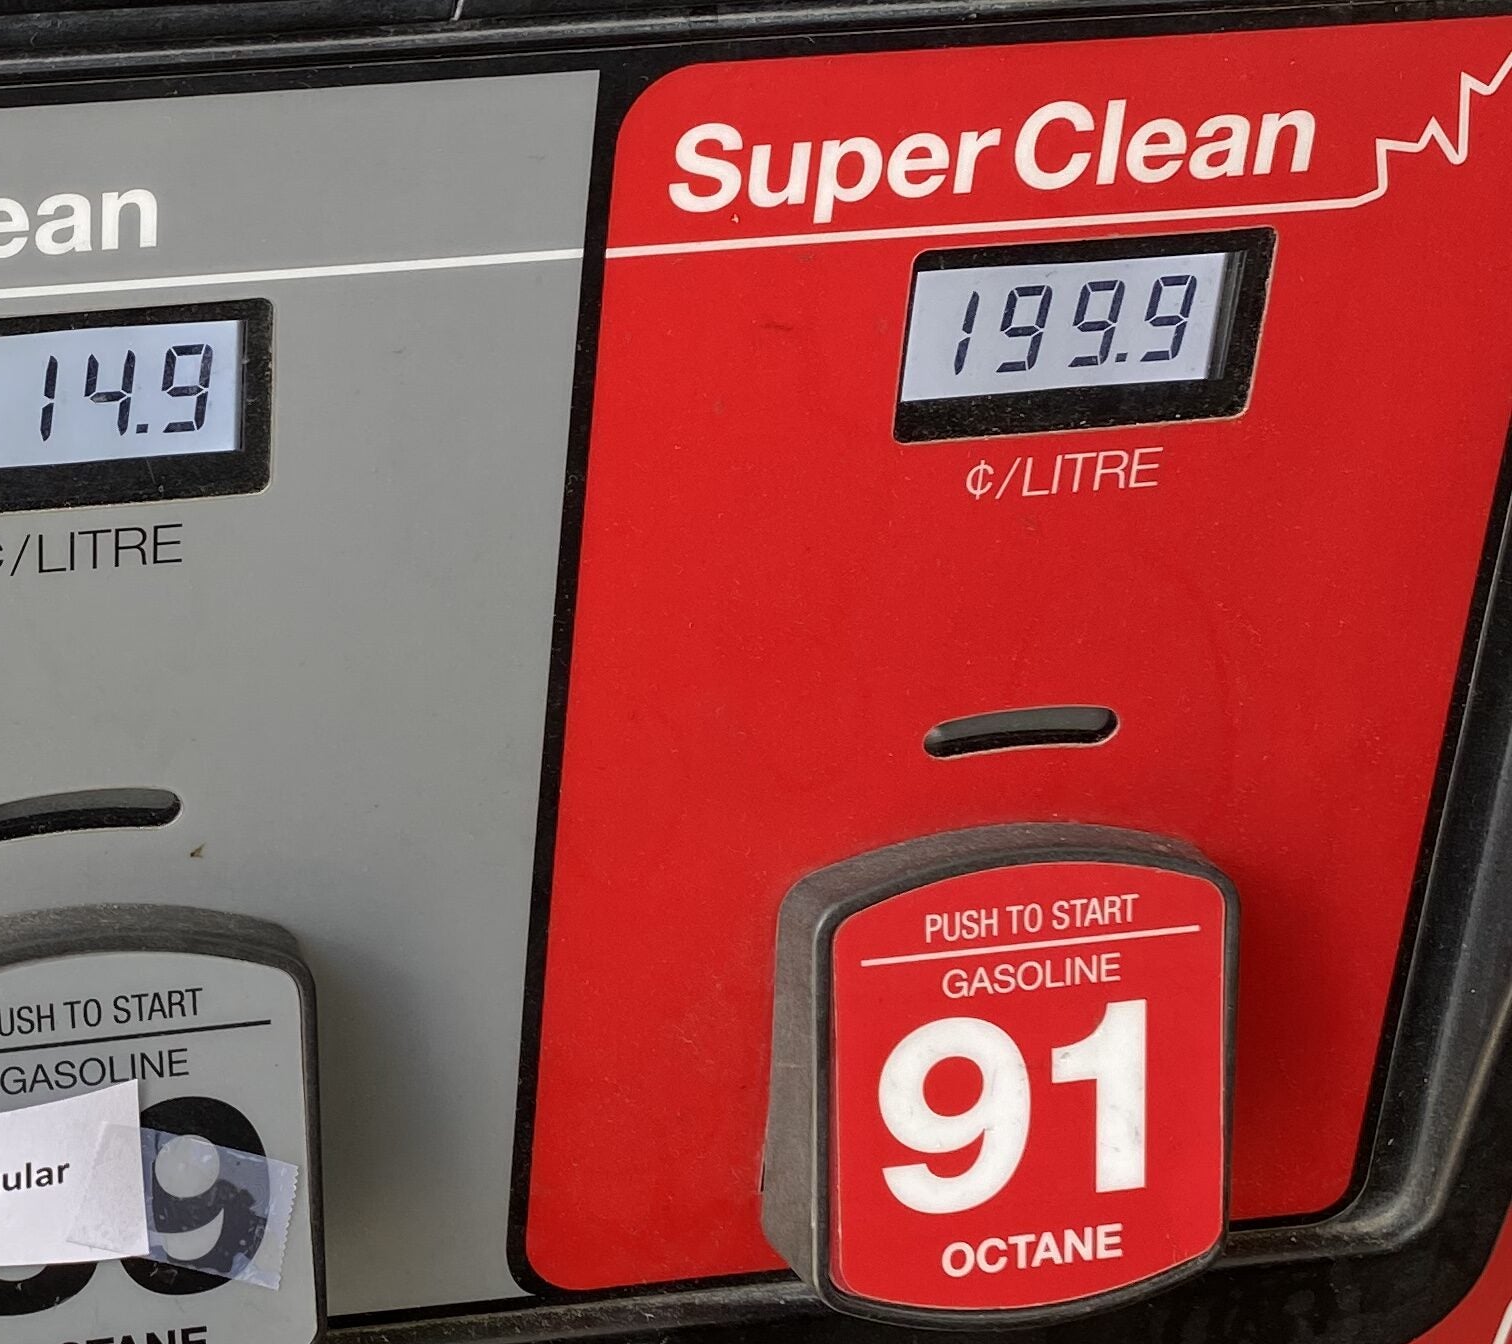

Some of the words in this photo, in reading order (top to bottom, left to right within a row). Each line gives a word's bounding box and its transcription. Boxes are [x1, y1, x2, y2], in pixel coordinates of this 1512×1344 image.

[667, 122, 1002, 224] Super
[1014, 98, 1318, 189] Clean
[954, 274, 1197, 376] 199.9
[925, 909, 999, 944] PUSH
[1007, 904, 1043, 936] TO
[1051, 893, 1139, 930] START
[942, 952, 1121, 999] GASOLINE
[63, 999, 101, 1031] TO
[113, 987, 204, 1026] START
[0, 1048, 189, 1096] GASOLINE
[878, 998, 1147, 1216] 91
[941, 1223, 1123, 1278] OCTANE
